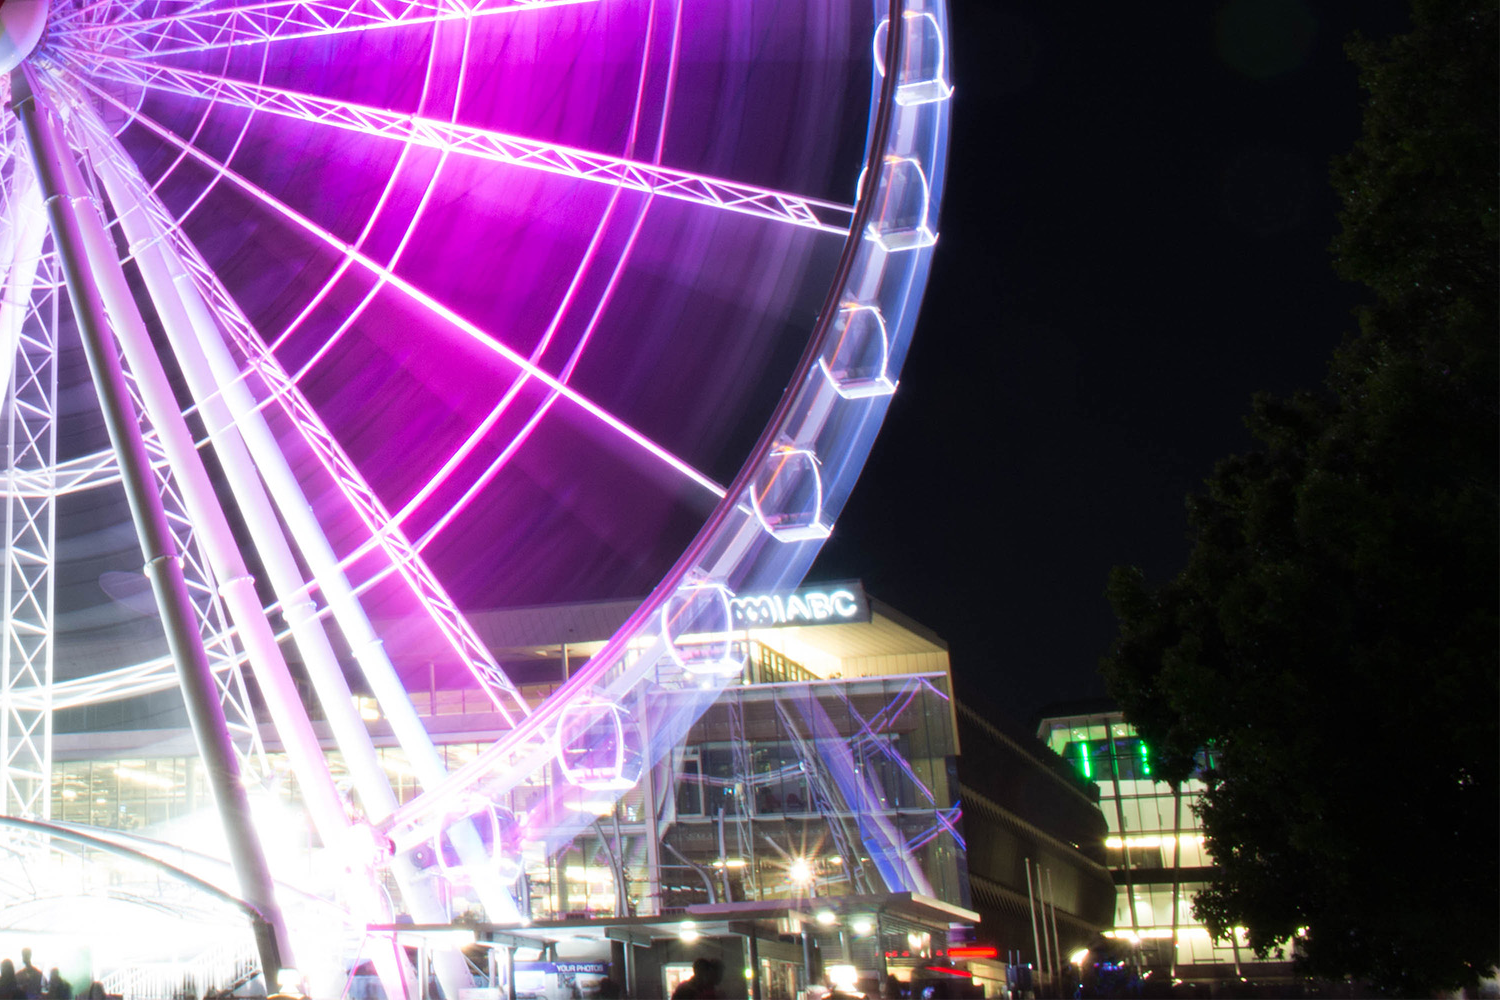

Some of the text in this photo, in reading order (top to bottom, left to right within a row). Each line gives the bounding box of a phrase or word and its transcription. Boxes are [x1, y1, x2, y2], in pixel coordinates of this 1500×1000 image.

[786, 588, 857, 621] ABC
[557, 964, 604, 973] YOUR PHOTOS
